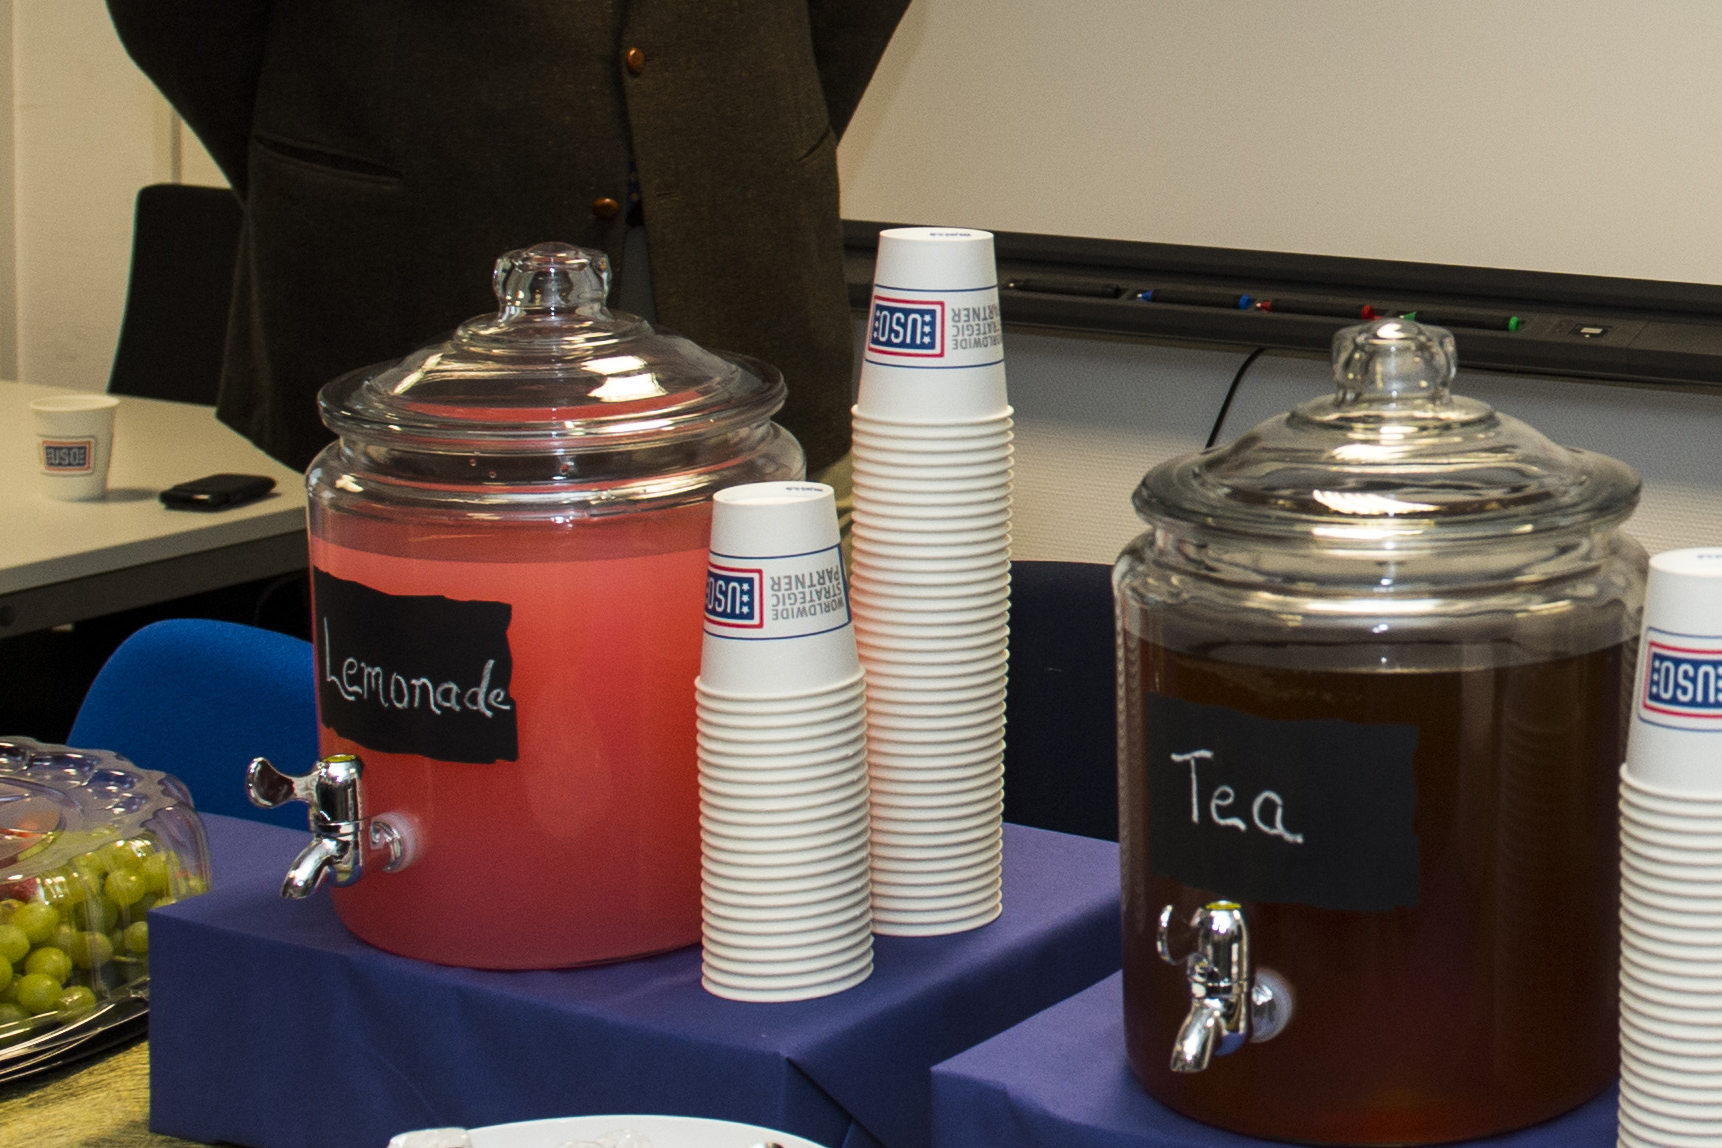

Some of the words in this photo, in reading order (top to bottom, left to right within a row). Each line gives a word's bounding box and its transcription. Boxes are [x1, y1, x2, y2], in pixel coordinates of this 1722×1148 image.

[879, 310, 922, 345] USO
[950, 305, 999, 323] ARTNER
[52, 448, 79, 465] USO
[769, 565, 840, 592] PARTNER
[771, 582, 843, 608] STRATEGIC
[771, 597, 845, 621] WORLDWIDE
[324, 616, 511, 718] Lemonade
[1659, 660, 1717, 703] USO
[1171, 749, 1304, 844] Tea
